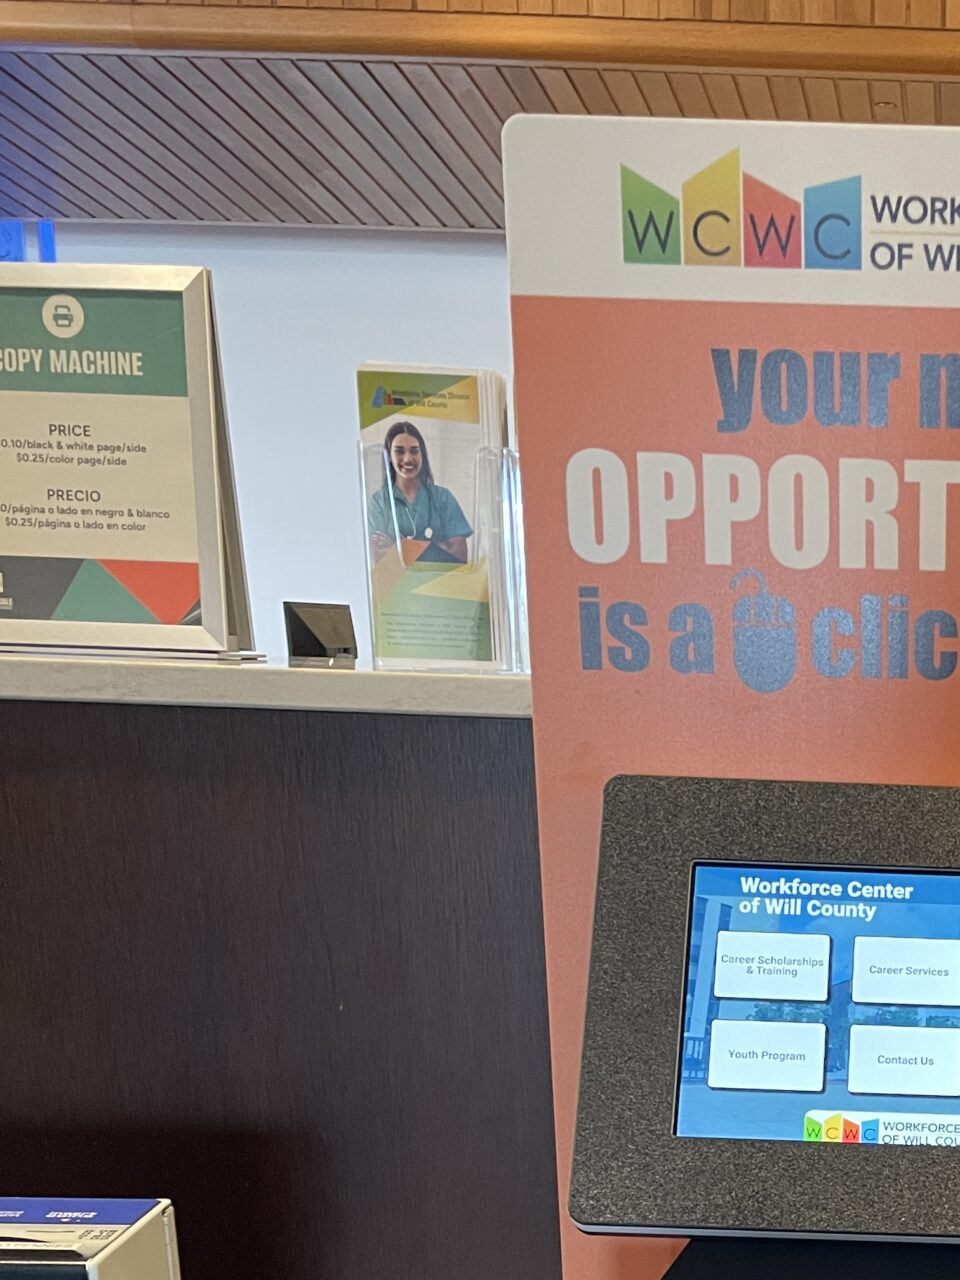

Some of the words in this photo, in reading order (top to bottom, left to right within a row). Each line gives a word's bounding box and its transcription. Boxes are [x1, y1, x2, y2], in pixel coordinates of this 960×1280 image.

[628, 207, 852, 260] WCWC
[870, 242, 914, 271] OF
[49, 349, 144, 376] MACHINE
[710, 348, 902, 433] your
[49, 424, 91, 437] PRICE
[56, 441, 63, 450] &
[66, 441, 94, 451] white
[96, 442, 147, 454] page/side
[16, 453, 74, 464] $0.25/color
[77, 455, 127, 467] page/side
[47, 489, 101, 502] PRECIO
[57, 505, 78, 516] lado
[95, 509, 124, 519] negro
[127, 508, 134, 517] &
[137, 509, 170, 519] blanco
[5, 517, 71, 530] $0.25/página
[83, 520, 104, 530] lado
[121, 522, 147, 531] color
[577, 585, 649, 673] is
[667, 602, 715, 675] a
[740, 876, 842, 896] Workforce
[847, 881, 913, 899] Center
[739, 899, 760, 914] of
[765, 899, 801, 915] Will
[806, 900, 877, 922] County
[721, 955, 754, 965] Career
[758, 956, 824, 968] Scholarships
[746, 966, 753, 975] &
[757, 966, 798, 978] Training
[869, 965, 903, 975] Career
[905, 966, 949, 977] Services
[728, 1049, 759, 1060] Youth
[761, 1050, 806, 1062] Program
[877, 1055, 917, 1065] Contact
[920, 1056, 934, 1066] Us
[806, 1126, 877, 1141] WCWC
[883, 1121, 960, 1134] WORKFORCE
[882, 1135, 899, 1145] OF
[903, 1135, 930, 1146] WILL
